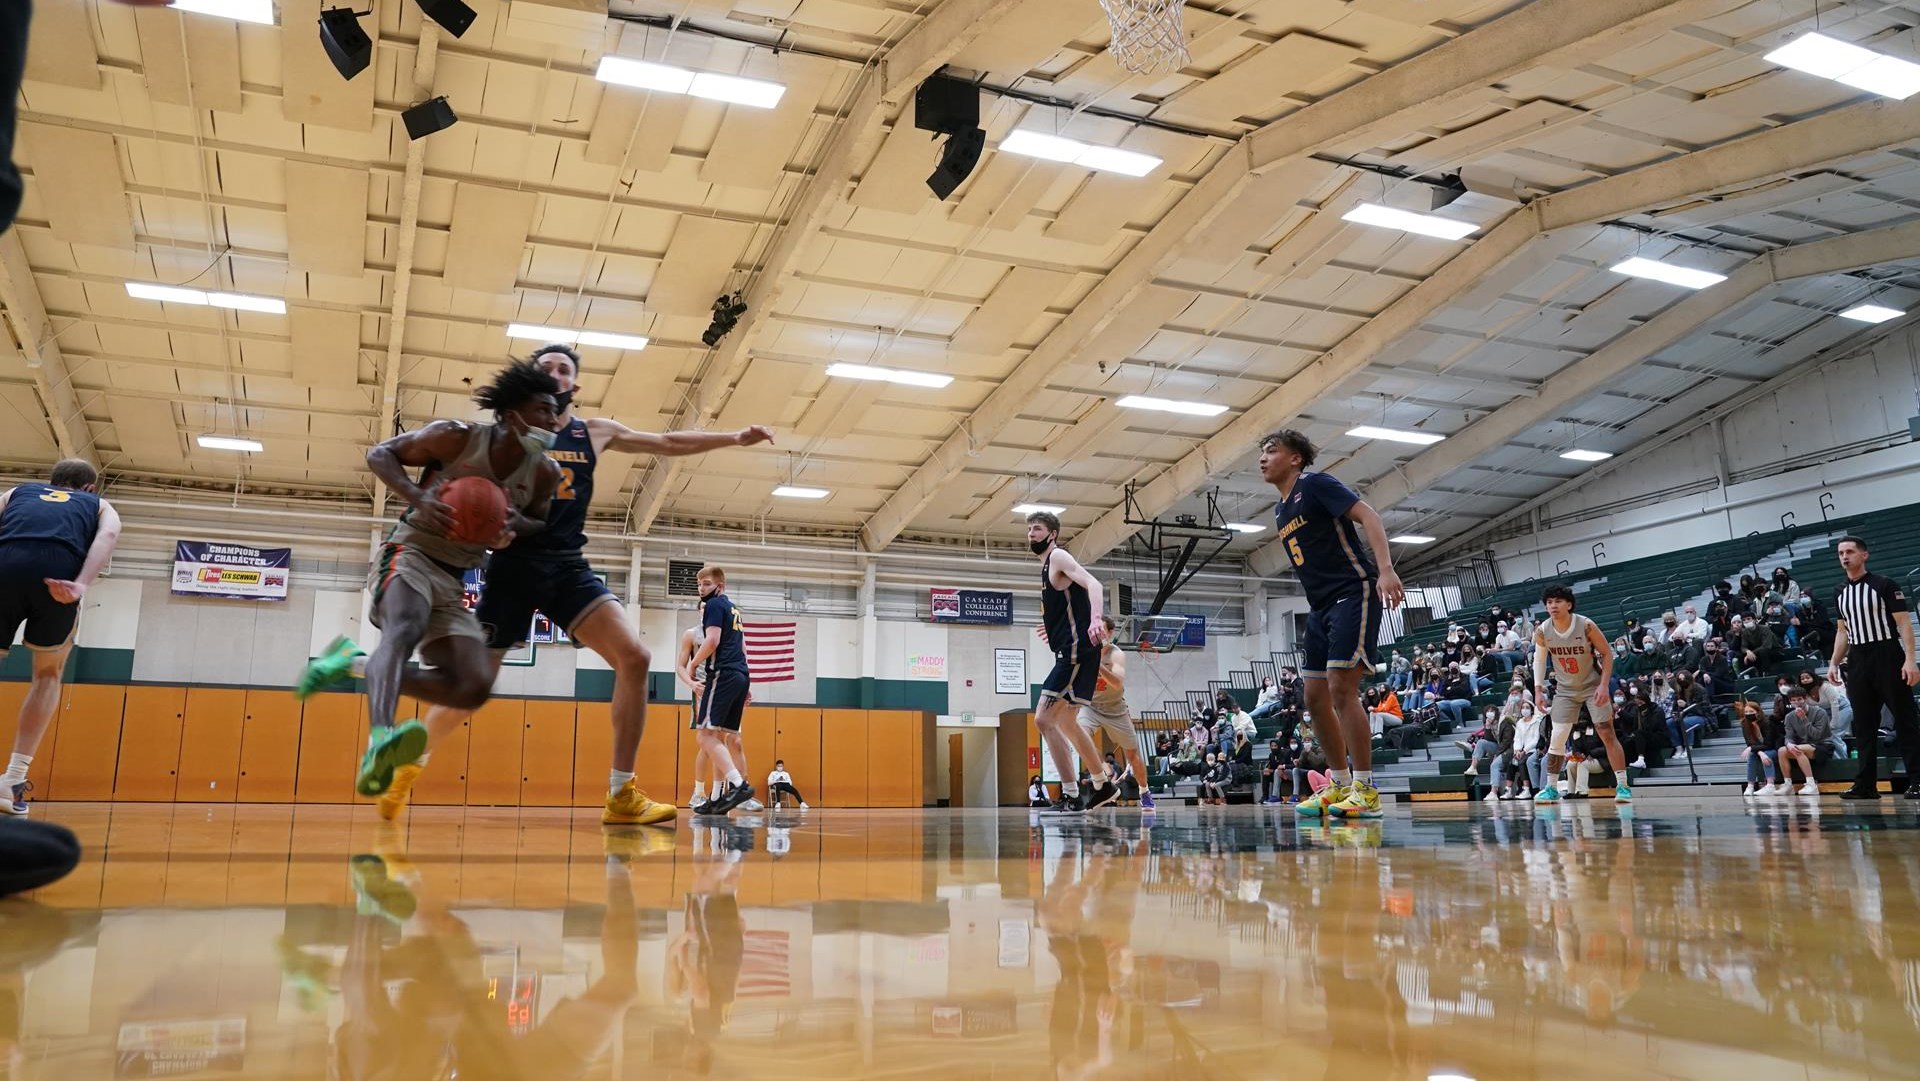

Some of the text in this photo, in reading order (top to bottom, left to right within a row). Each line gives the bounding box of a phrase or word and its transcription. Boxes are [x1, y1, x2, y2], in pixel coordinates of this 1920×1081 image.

[209, 545, 260, 557] CHAMPIONS
[1288, 536, 1305, 566] 5
[200, 553, 267, 566] OF CHARACTER
[1550, 646, 1584, 655] WOLVES
